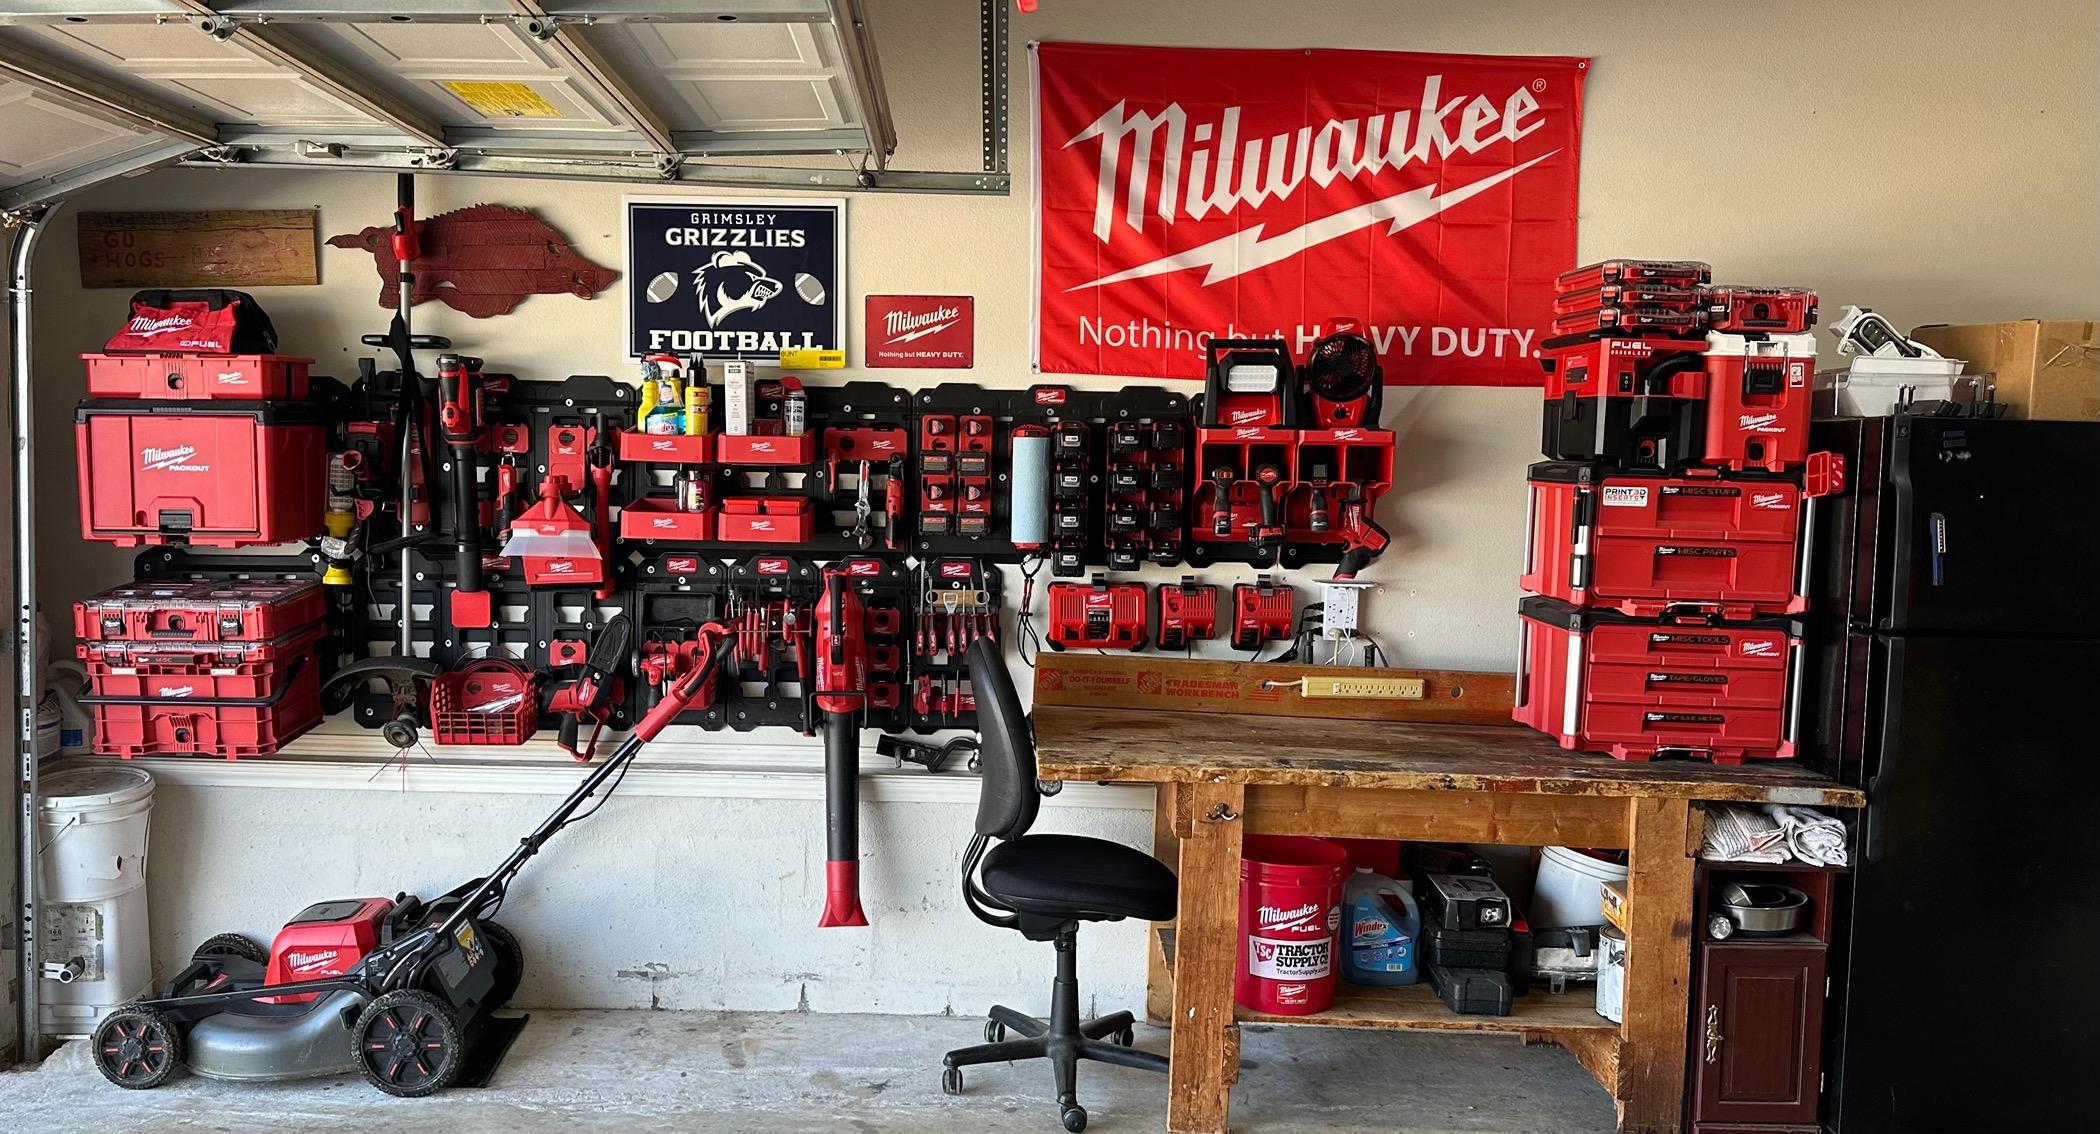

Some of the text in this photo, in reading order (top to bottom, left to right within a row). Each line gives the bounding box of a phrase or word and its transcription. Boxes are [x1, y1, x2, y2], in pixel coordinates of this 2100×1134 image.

[691, 212, 777, 225] GRIMSLEY
[103, 231, 135, 249] GO
[665, 227, 806, 248] GRIZZLIES
[105, 252, 165, 269] HOGS
[131, 314, 193, 331] Milwaukee
[882, 305, 960, 337] Milwaukee
[191, 340, 222, 348] FUEL
[649, 329, 823, 351] FOOTBALL
[1079, 315, 1215, 360] Nothing
[1296, 324, 1420, 357] HVY
[1431, 328, 1541, 358] DUTY.
[1611, 341, 1651, 349] FUEL
[879, 351, 904, 359] Nothing
[1740, 413, 1777, 427] Milwaukee
[141, 444, 195, 465] Milwaukee
[1682, 487, 1705, 496] MISC
[1677, 547, 1701, 555] MISC
[1702, 548, 1734, 556] PARTS
[1696, 636, 1729, 644] TOOLS
[1069, 675, 1131, 685] DO-IT-YOURSELF
[1166, 679, 1239, 690] TRADESMAN
[1166, 688, 1240, 699] WORKBENCH
[1257, 903, 1320, 925] Milwaukee
[1354, 920, 1389, 937] Windex
[1255, 941, 1272, 960] TSC
[1276, 942, 1330, 957] TRACTOR
[287, 950, 338, 968] Milwaukee
[1276, 956, 1320, 968] SUPPLY
[1276, 966, 1328, 976] TractorSupply.com
